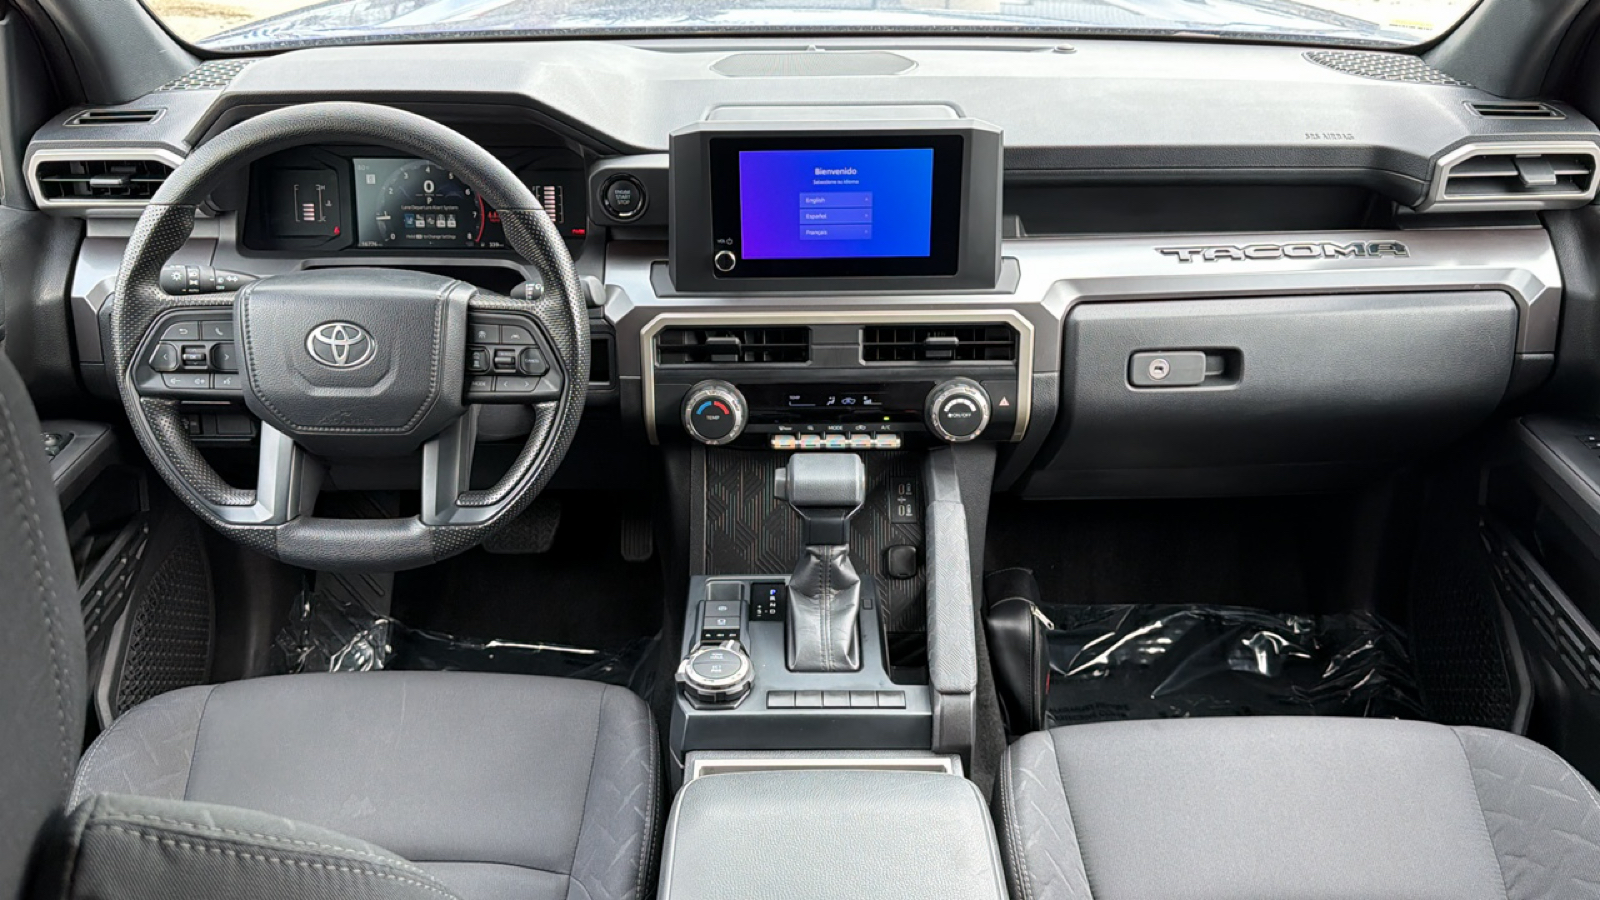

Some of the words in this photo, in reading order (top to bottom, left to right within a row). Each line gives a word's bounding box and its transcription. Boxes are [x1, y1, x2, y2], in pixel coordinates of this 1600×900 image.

[814, 166, 857, 176] Bienvenido
[423, 180, 435, 194] 0
[805, 197, 826, 205] English
[1154, 239, 1411, 264] TACOMA
